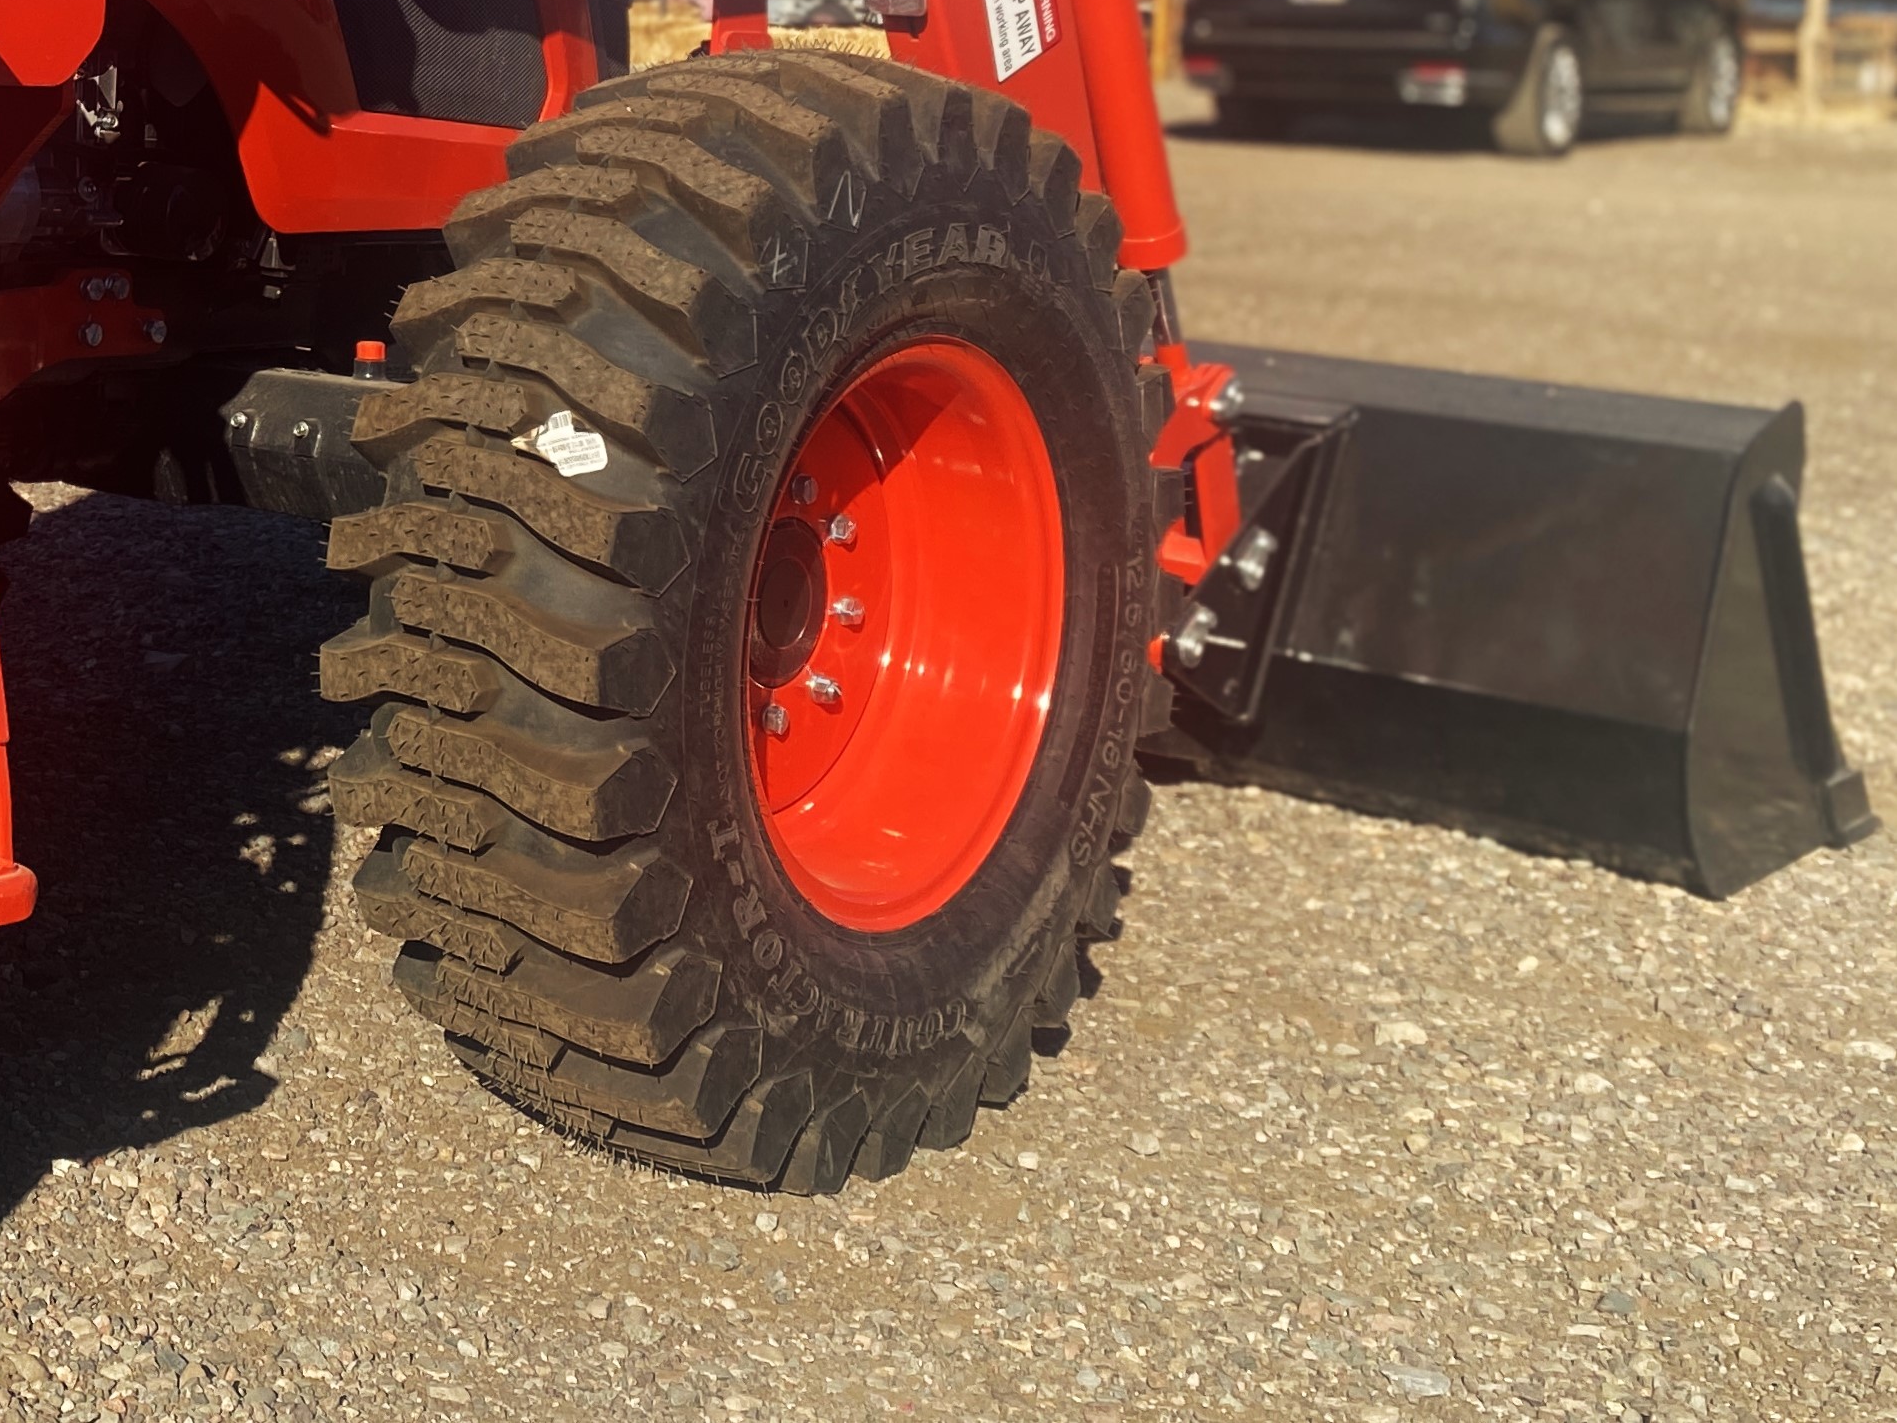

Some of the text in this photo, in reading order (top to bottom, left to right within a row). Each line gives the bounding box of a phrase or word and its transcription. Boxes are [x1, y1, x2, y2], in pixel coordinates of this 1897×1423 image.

[995, 4, 1010, 48] working
[1014, 9, 1036, 57] AWAY
[1002, 47, 1013, 73] area
